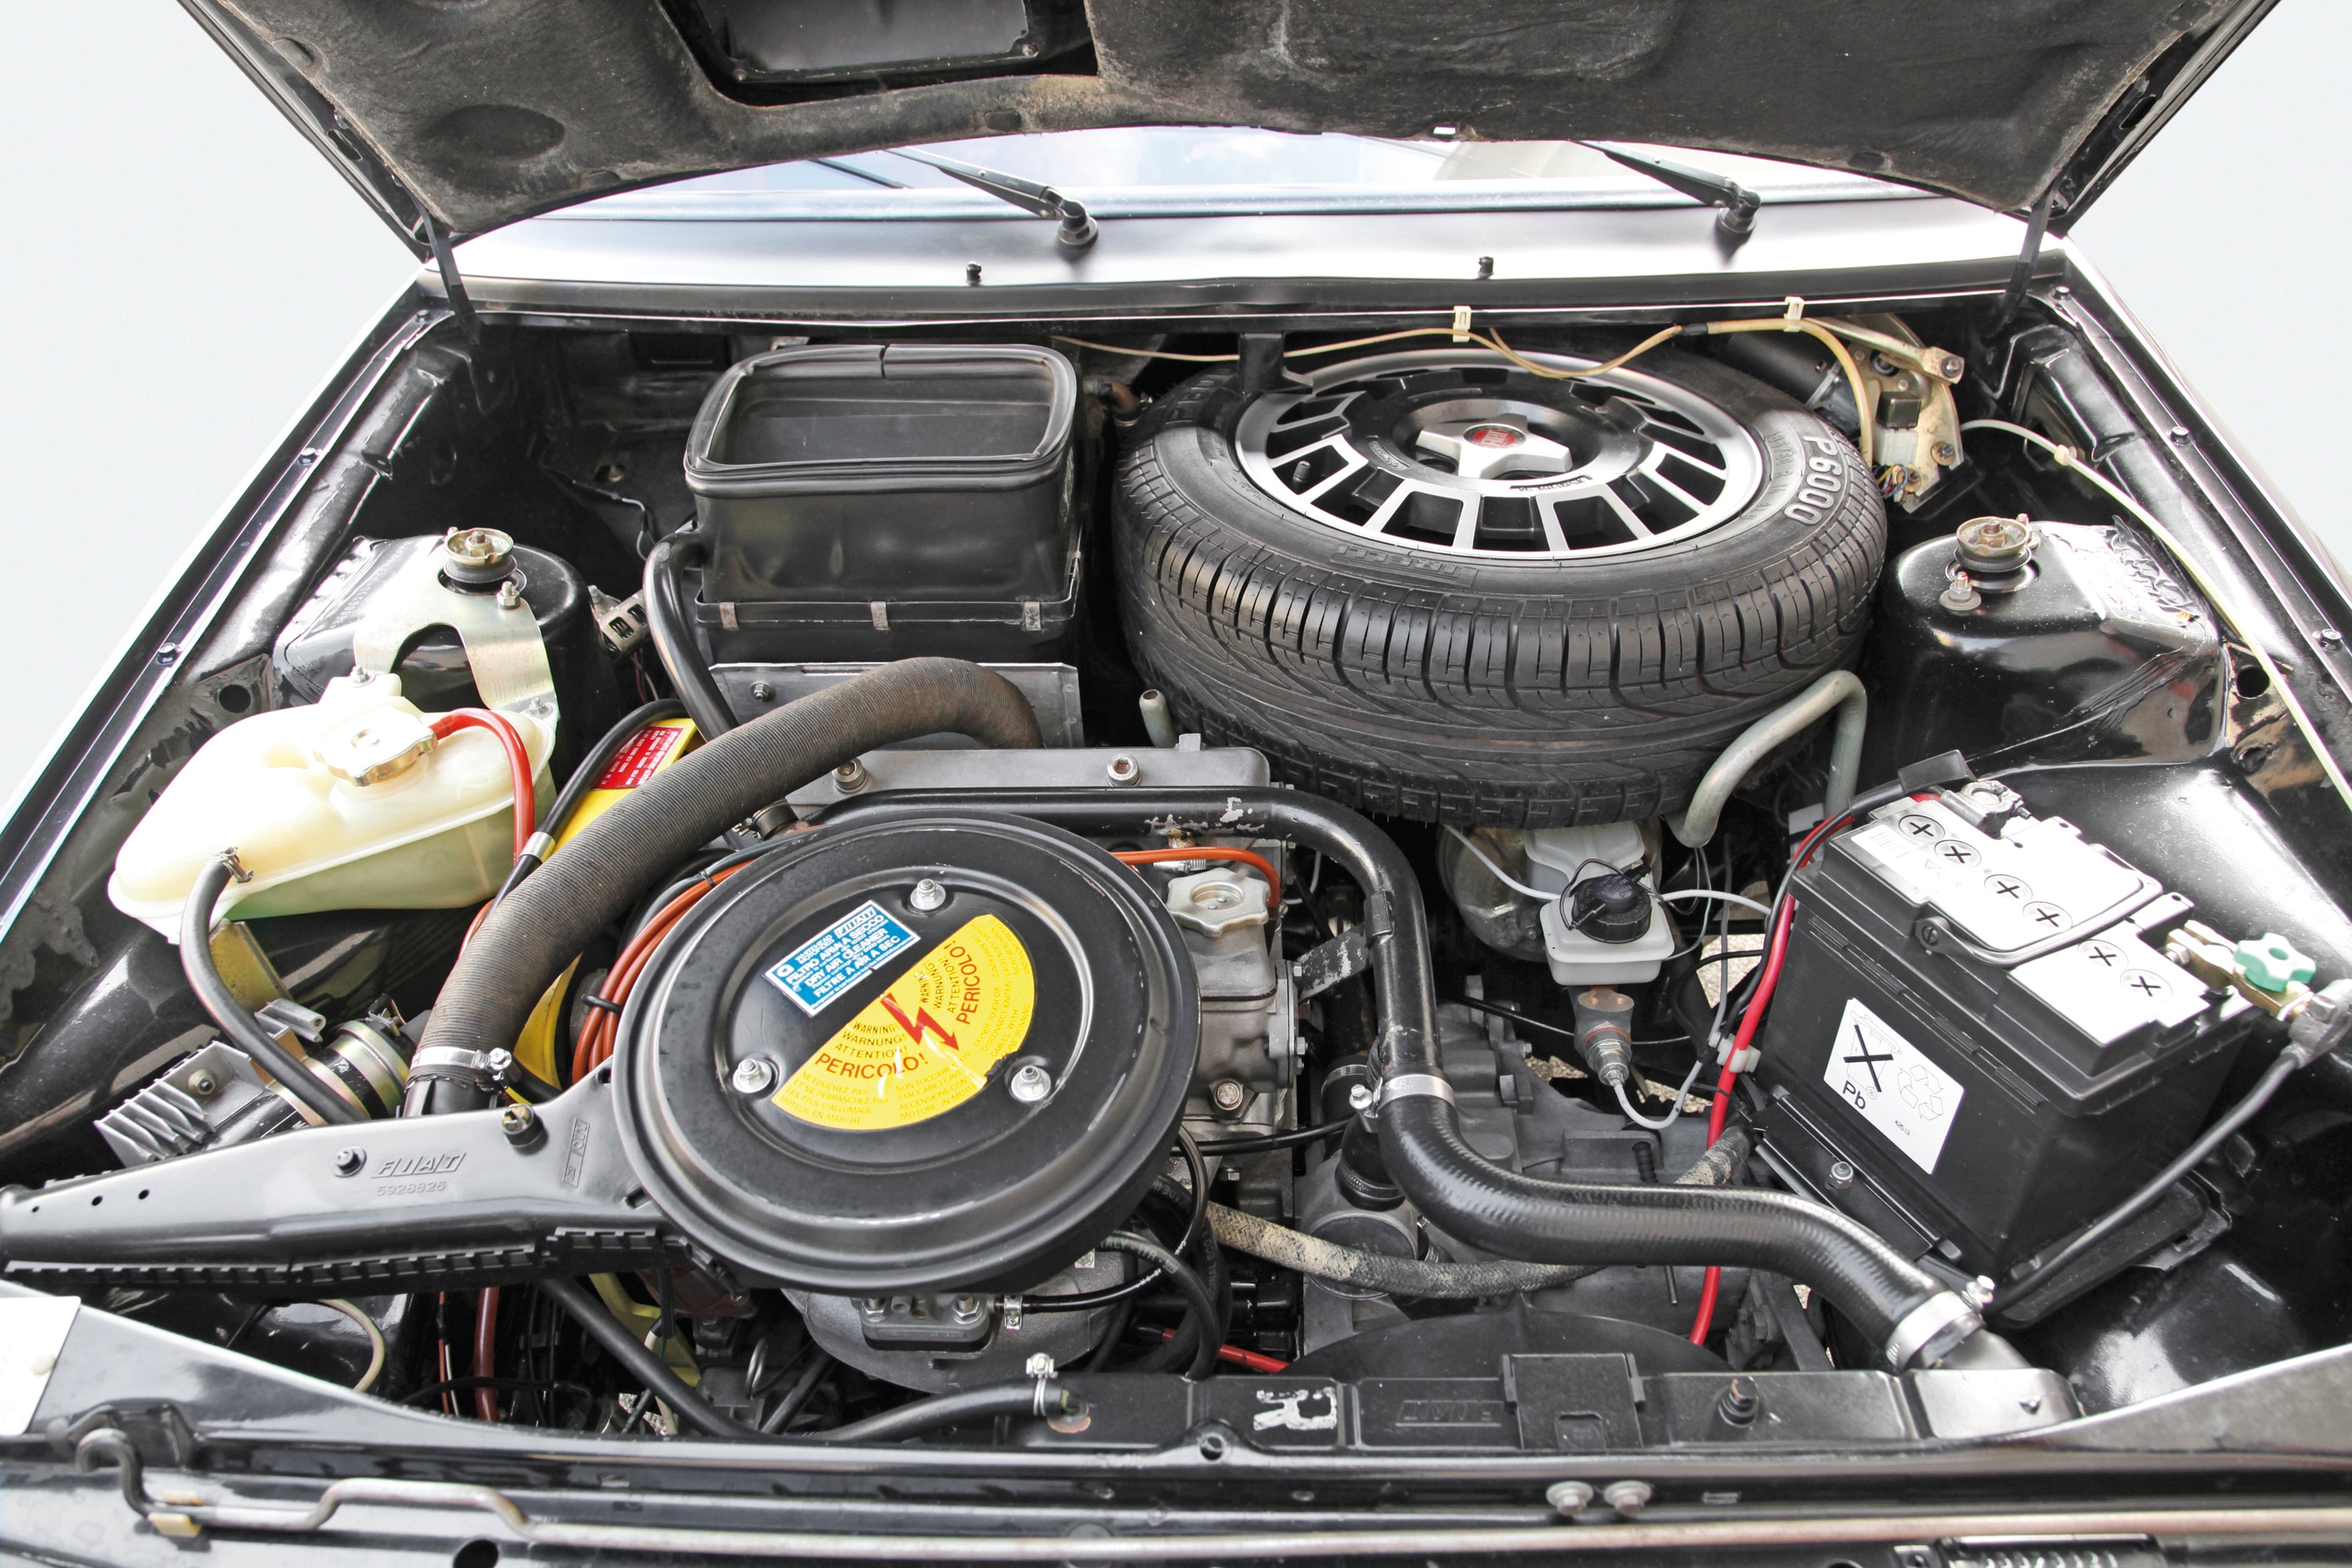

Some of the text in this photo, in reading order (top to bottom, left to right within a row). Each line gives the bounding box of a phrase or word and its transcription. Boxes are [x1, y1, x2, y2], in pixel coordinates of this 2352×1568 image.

[835, 907, 875, 937] FIAT
[786, 958, 820, 985] FILTRO
[841, 936, 852, 947] A
[848, 915, 885, 939] SECCO
[804, 928, 888, 987] DRY AIR CLEANER
[813, 935, 900, 998] FILTRE A AIR A SEC
[922, 959, 945, 1009] WARNUNG!
[938, 957, 961, 1014] ATTENTION!
[943, 940, 981, 1025] PERICOLO!
[842, 1031, 908, 1044] WARNUNG!
[854, 1021, 900, 1034] WARNING!
[982, 1009, 1008, 1052] DISCONNECT
[990, 1009, 1019, 1057] CABLES WITH
[814, 1053, 928, 1079] PERICOLO!
[897, 1085, 937, 1101] STACCARE
[1842, 1081, 1866, 1110] Pb
[377, 1154, 462, 1176] FIAT
[377, 1181, 446, 1196] 5928826
